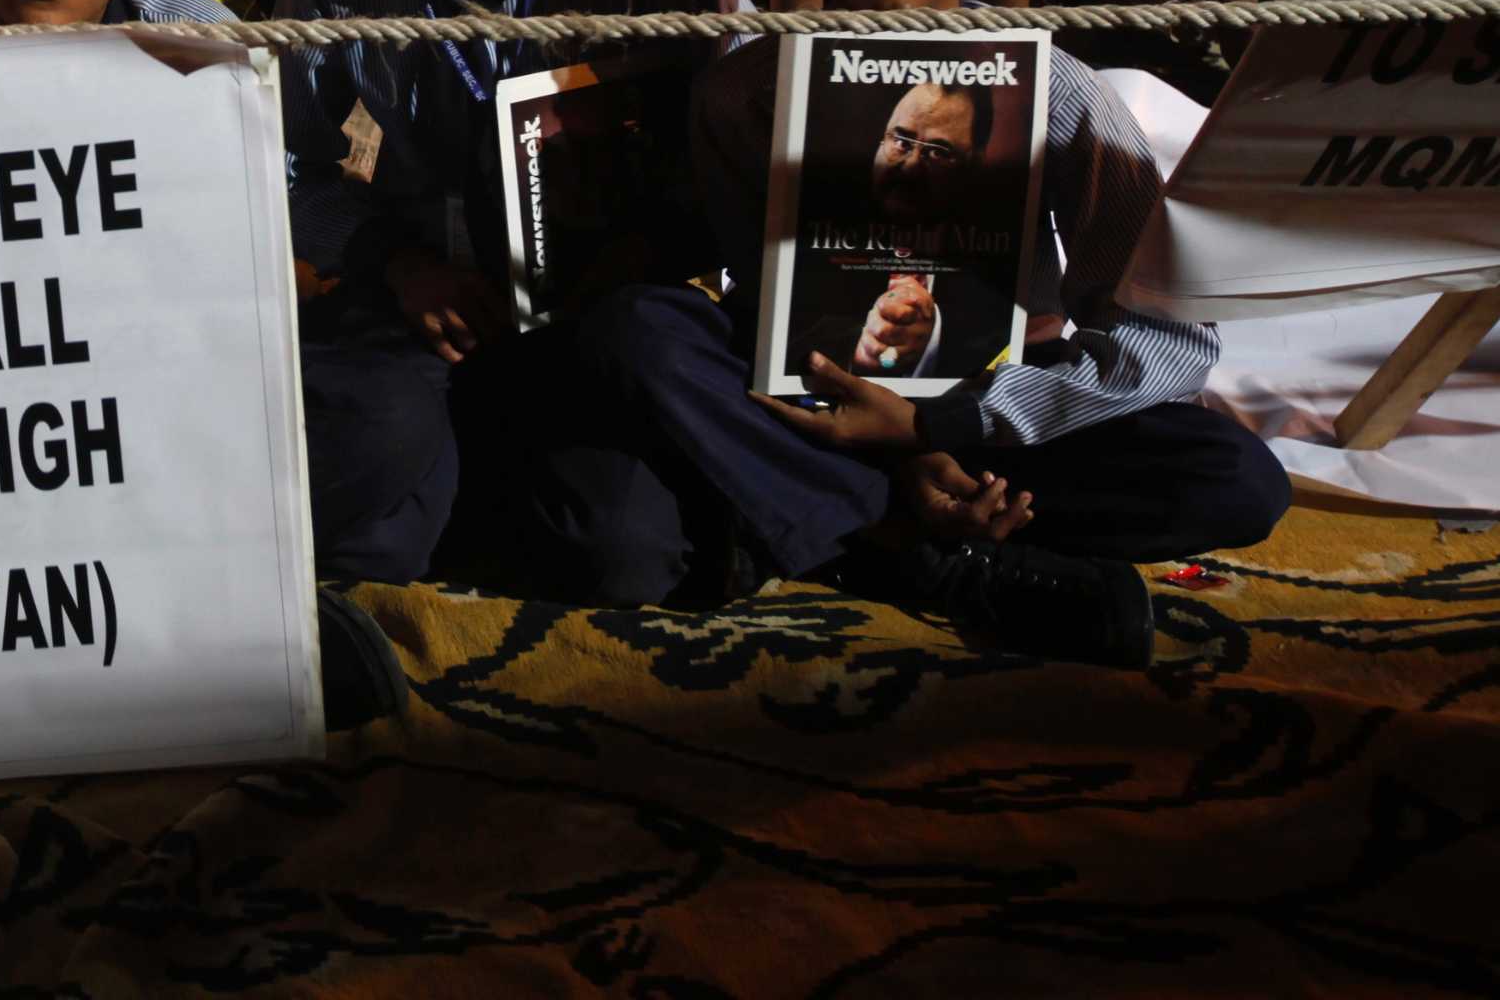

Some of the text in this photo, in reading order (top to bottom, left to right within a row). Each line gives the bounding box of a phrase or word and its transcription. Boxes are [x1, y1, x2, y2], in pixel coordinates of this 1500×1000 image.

[443, 39, 467, 71] PUBLIC
[1453, 13, 1500, 85] S
[830, 50, 1019, 87] Newsweek
[810, 220, 1012, 258] The Right Man
